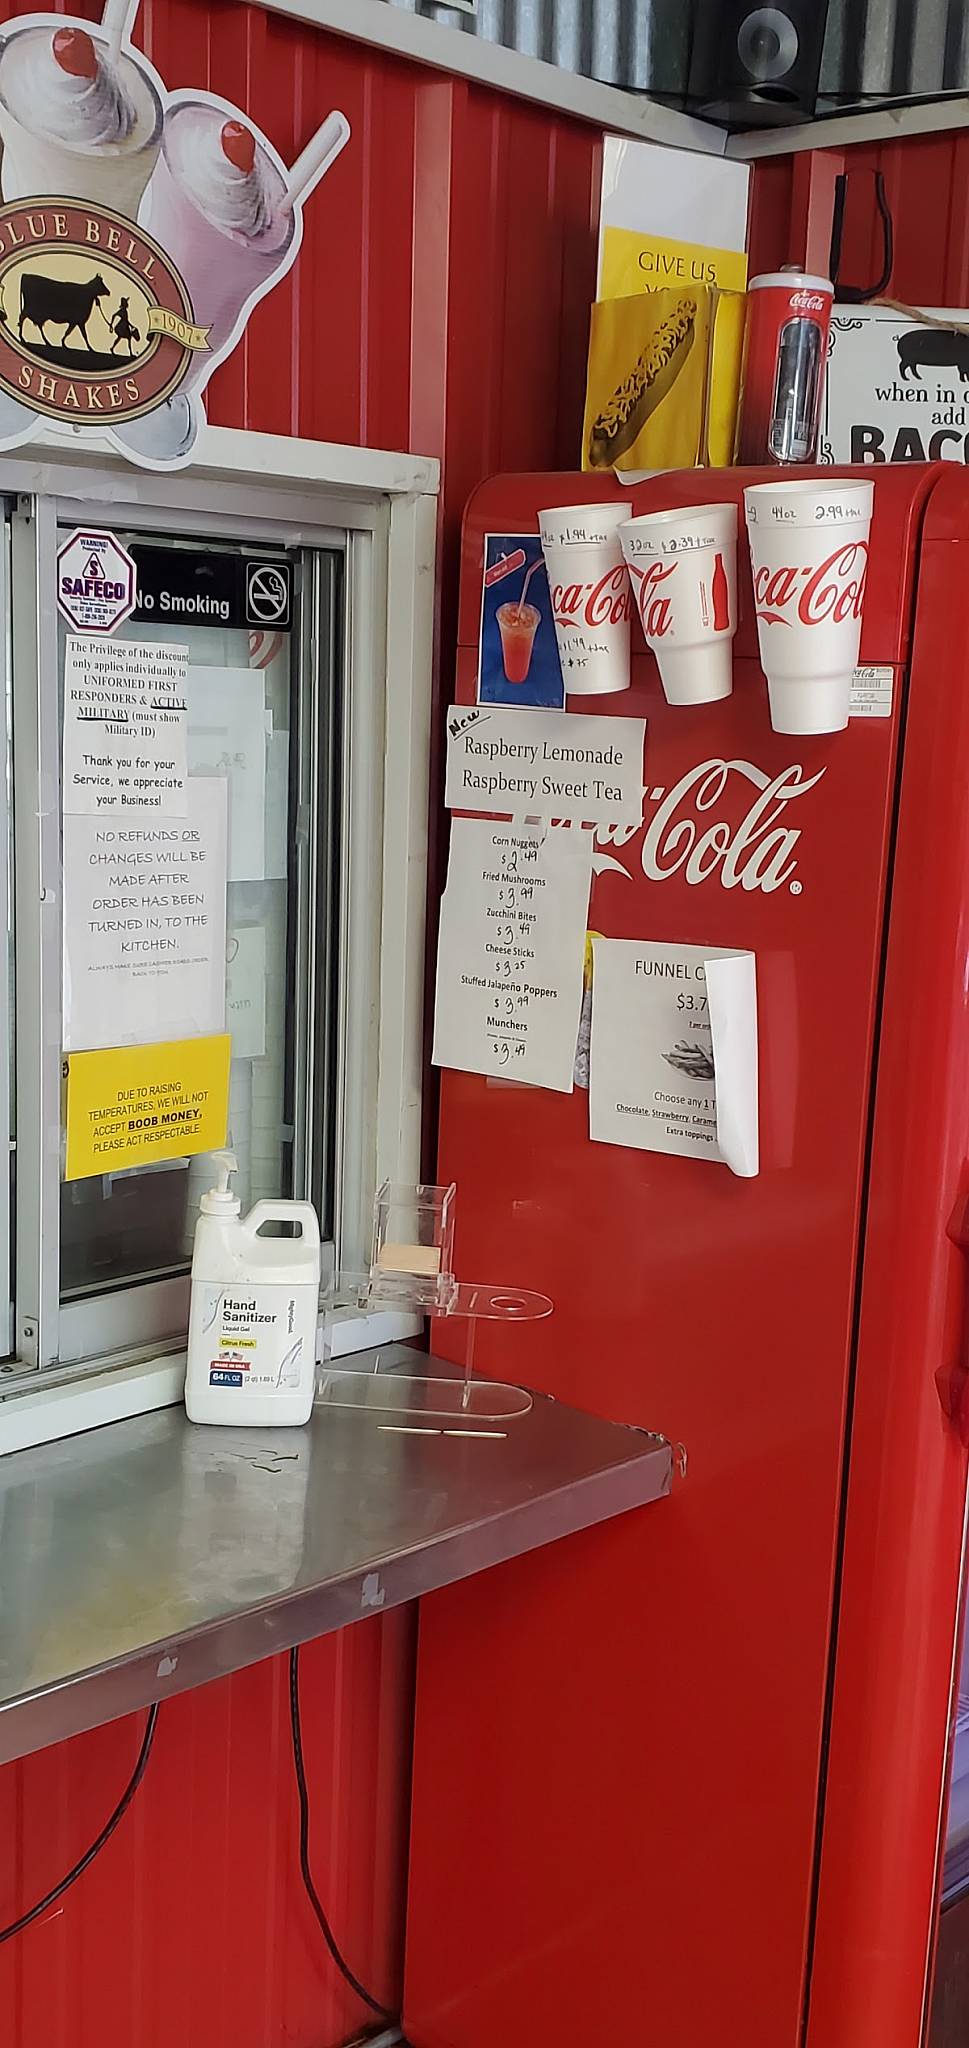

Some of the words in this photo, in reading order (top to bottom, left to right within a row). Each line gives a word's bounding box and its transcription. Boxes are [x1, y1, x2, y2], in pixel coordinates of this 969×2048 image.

[85, 219, 155, 280] BELL
[638, 251, 686, 277] GIVE
[691, 260, 716, 283] US
[161, 313, 194, 343] 1907
[18, 365, 139, 409] SHAKES
[874, 382, 928, 402] when
[936, 384, 956, 403] in
[931, 407, 966, 426] add
[850, 425, 969, 464] BAC
[815, 506, 843, 519] 2.99
[90, 560, 98, 576] S
[62, 577, 125, 600] SAFECO
[136, 590, 154, 609] No
[160, 591, 229, 619] Smoking
[70, 641, 87, 653] The
[89, 643, 127, 657] Privilege
[128, 647, 138, 657] of
[139, 648, 153, 659] the
[156, 650, 189, 662] discount
[73, 659, 91, 671] only
[94, 661, 124, 673] applies
[125, 662, 176, 678] individually
[178, 668, 186, 677] to
[84, 675, 145, 690] UNIFORMED
[148, 680, 178, 692] FIRST
[70, 690, 137, 705] RESPONDERS
[139, 695, 147, 705] &
[151, 696, 187, 709] ACTIVE
[78, 706, 129, 720] MILITARY
[132, 711, 157, 722] (must
[159, 712, 180, 723] show
[448, 709, 480, 737] New
[105, 724, 138, 738] Military
[141, 726, 156, 738] ID)
[464, 736, 538, 764] Raspberry
[542, 742, 623, 765] Lemonade
[82, 755, 113, 767] Thank
[116, 759, 131, 770] you
[136, 757, 150, 769] for
[154, 761, 175, 771] your
[73, 773, 114, 787] Service,
[118, 778, 130, 786] we
[133, 777, 183, 789] appreciate
[463, 769, 538, 798] Raspberry
[542, 776, 588, 798] Sweet
[592, 780, 622, 800] Tea
[96, 795, 117, 807] your
[121, 794, 161, 806] Business!
[96, 831, 115, 843] NO
[118, 830, 179, 842] REFUNDS
[182, 830, 200, 842] OR
[492, 835, 509, 846] Corn
[511, 837, 539, 850] Nuggets
[89, 852, 153, 866] CHANGES
[156, 851, 188, 863] WILL
[190, 850, 206, 861] BE
[109, 874, 145, 886] MADE
[148, 873, 189, 885] AFTER
[482, 871, 500, 881] Fried
[501, 873, 546, 886] Mushrooms
[92, 897, 139, 910] ORDER
[141, 895, 169, 907] HAS
[171, 894, 204, 905] BEEN
[486, 907, 516, 919] Zucchini
[518, 911, 537, 922] Bites
[88, 919, 143, 932] TURNED
[146, 918, 162, 929] IN,
[165, 917, 182, 927] TO
[184, 915, 208, 926] THE
[121, 938, 179, 952] KITCHEN.
[485, 943, 512, 955] Cheese
[513, 947, 535, 958] Sticks
[635, 960, 691, 979] FUNNEL
[695, 966, 707, 981] C
[460, 974, 486, 987] Stuffed
[487, 979, 521, 992] Jalapeño
[523, 984, 558, 998] Poppers
[486, 1016, 528, 1031] Munchers
[117, 1089, 134, 1101] DUE
[137, 1087, 148, 1098] TO
[149, 1081, 182, 1095] RAISING
[157, 1098, 171, 1109] WE
[171, 1095, 190, 1107] WILL
[192, 1091, 209, 1103] NOT
[654, 1091, 685, 1105] Choose
[687, 1098, 701, 1109] any
[704, 1099, 709, 1110] 1
[93, 1121, 126, 1137] ACCEPT
[128, 1116, 158, 1130] BOOB
[161, 1108, 202, 1124] MONEY,
[666, 1126, 683, 1136] Extra
[685, 1129, 713, 1141] toppings
[93, 1138, 125, 1153] PLEASE
[126, 1134, 142, 1147] ACT
[223, 1299, 256, 1311] Hand
[222, 1311, 277, 1323] Sanitizer
[213, 1372, 223, 1381] 64
